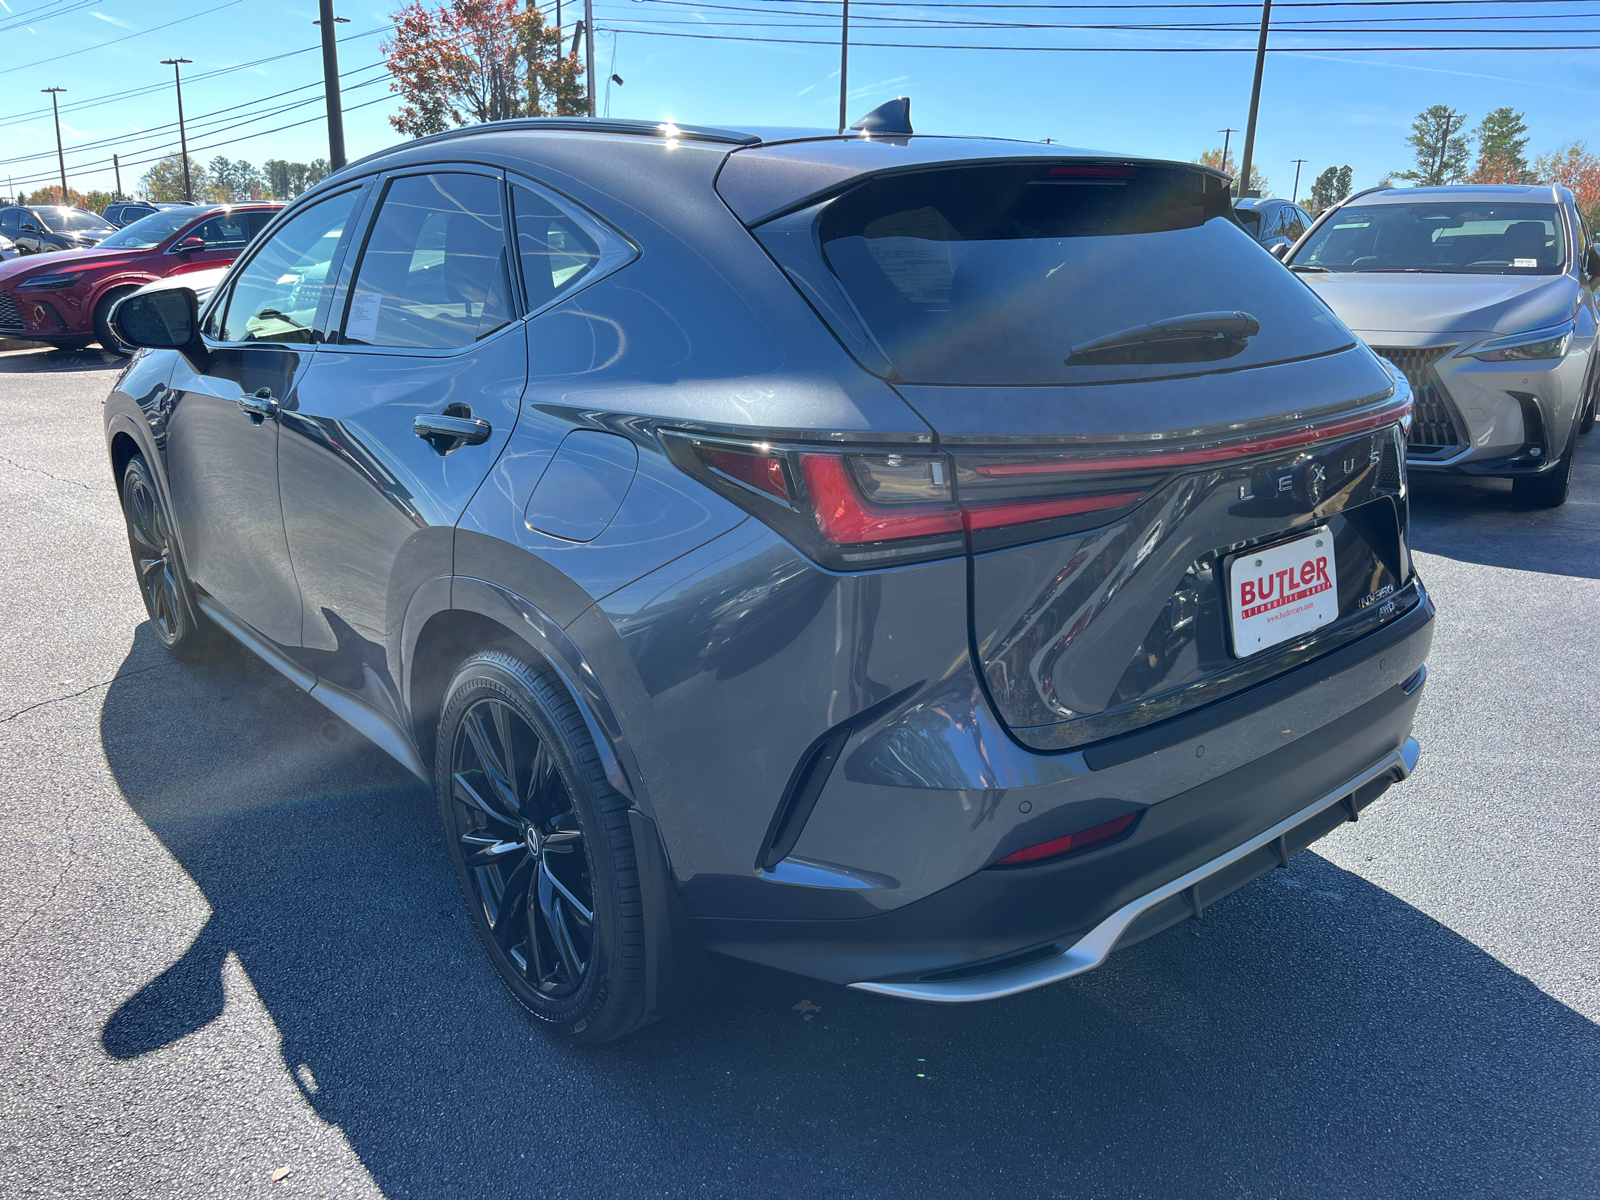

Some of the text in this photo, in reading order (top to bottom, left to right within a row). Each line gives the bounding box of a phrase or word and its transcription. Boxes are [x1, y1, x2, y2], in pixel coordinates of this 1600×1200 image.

[1239, 451, 1380, 500] LEXUS
[1242, 581, 1331, 618] AUTOMOTIVE GROUP
[1266, 602, 1315, 624] www.butlercars.com
